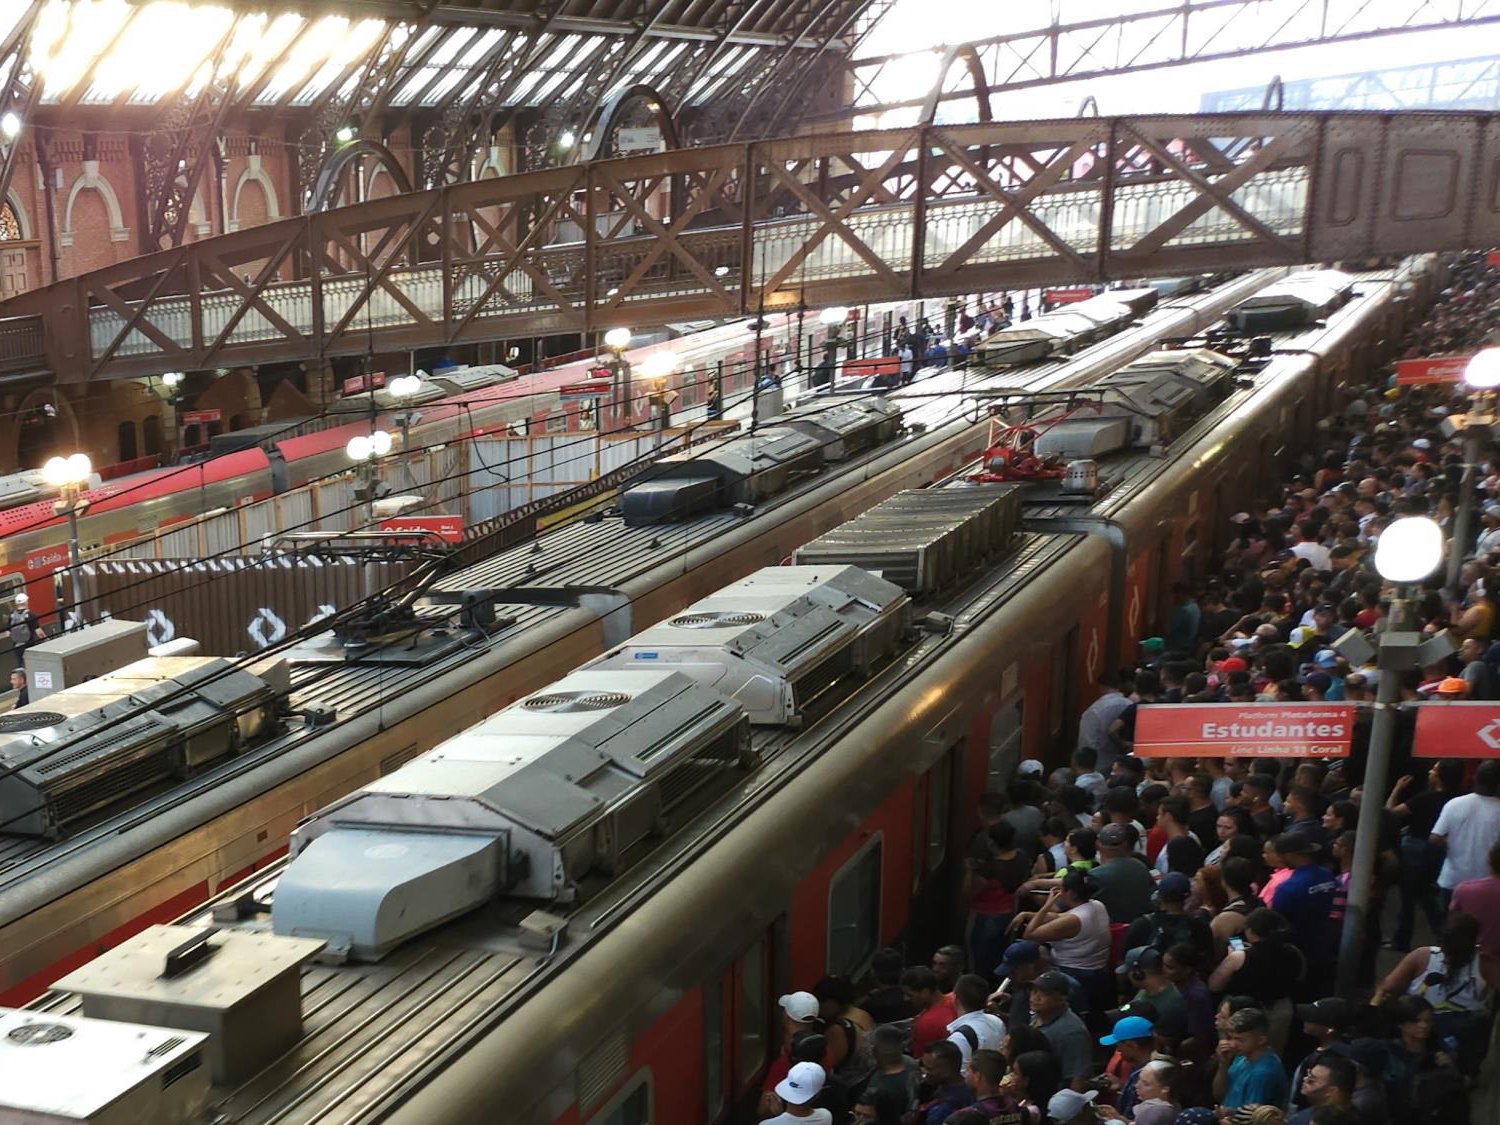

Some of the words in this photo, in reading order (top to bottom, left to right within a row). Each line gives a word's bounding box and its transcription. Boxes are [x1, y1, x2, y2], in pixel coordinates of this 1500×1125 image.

[1281, 710, 1338, 719] Plataforma
[1202, 722, 1344, 739] Estudantes
[1257, 745, 1291, 754] Linha
[1293, 745, 1307, 754] 11
[1309, 744, 1343, 754] Coral
